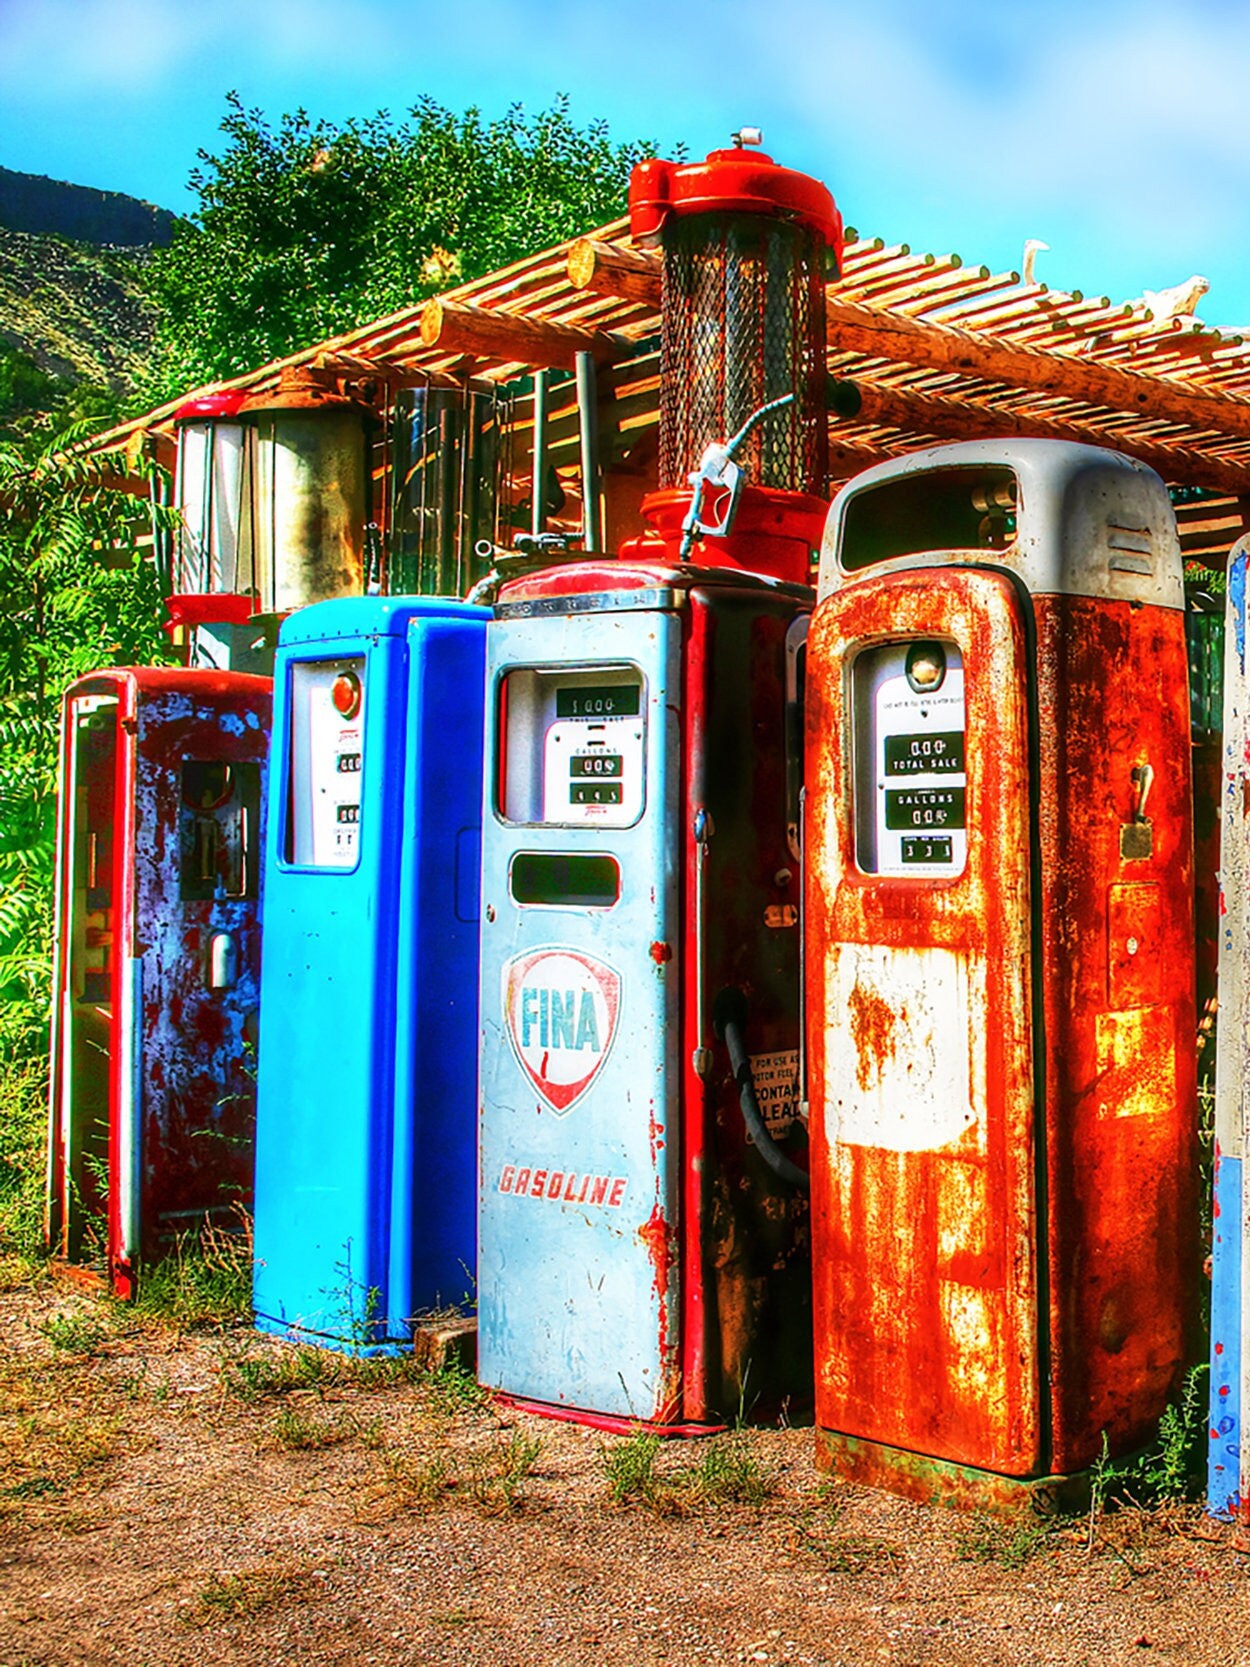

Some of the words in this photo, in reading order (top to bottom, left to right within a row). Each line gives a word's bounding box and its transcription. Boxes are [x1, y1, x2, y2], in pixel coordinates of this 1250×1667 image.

[894, 760, 924, 769] TOTAL
[931, 758, 957, 767] SALE
[898, 794, 953, 804] GALLONS
[522, 987, 600, 1052] FINA
[499, 1166, 626, 1206] GASOLINE
